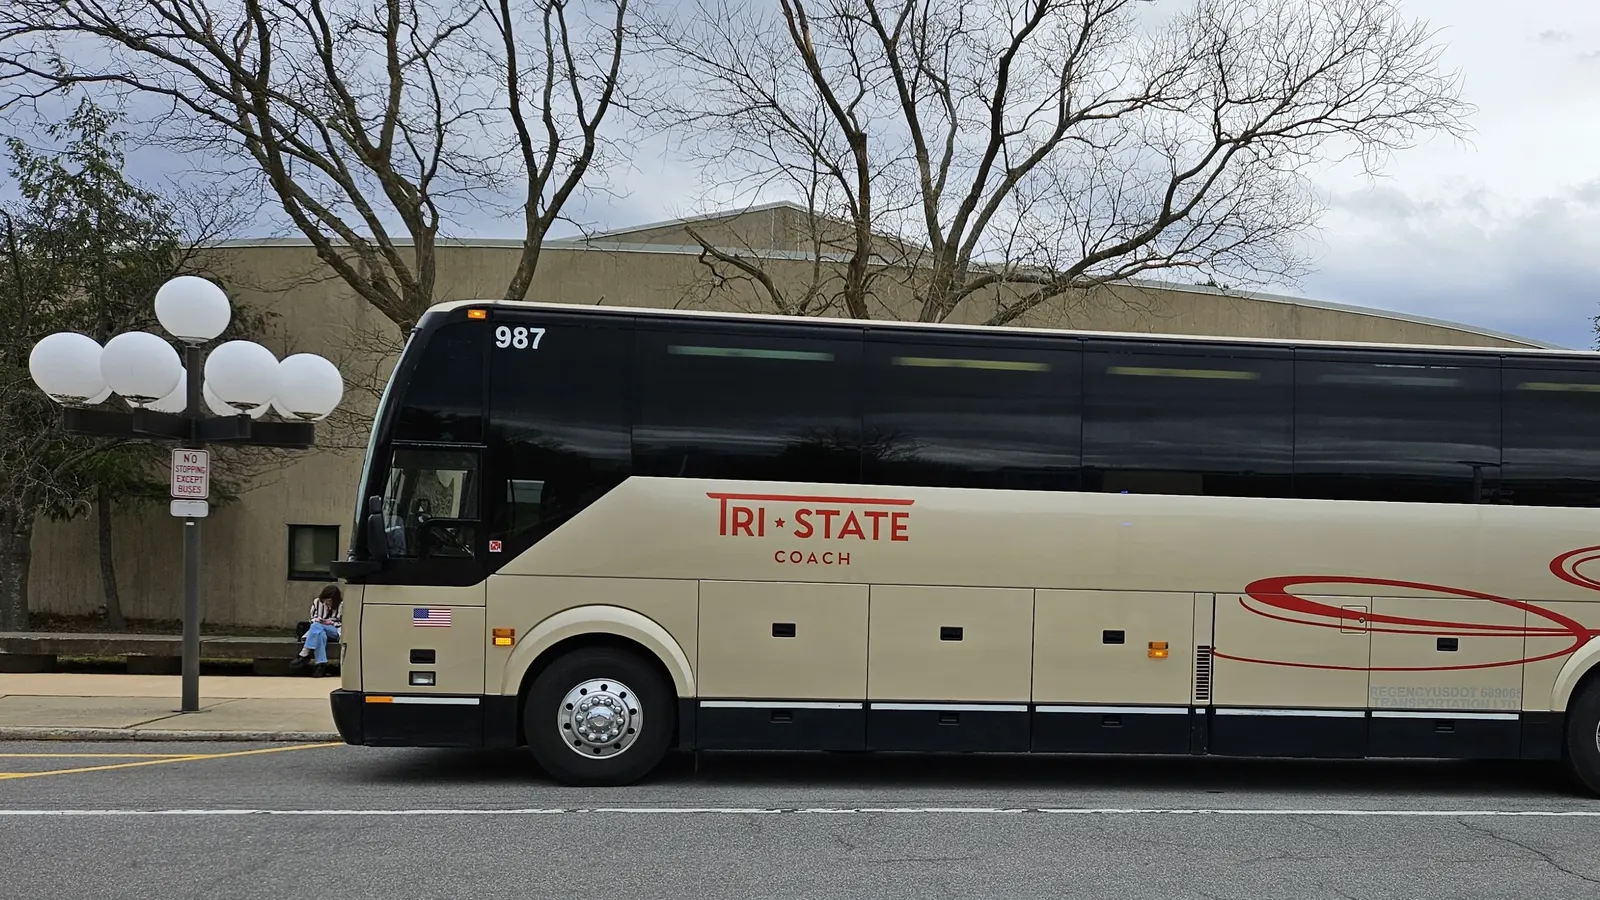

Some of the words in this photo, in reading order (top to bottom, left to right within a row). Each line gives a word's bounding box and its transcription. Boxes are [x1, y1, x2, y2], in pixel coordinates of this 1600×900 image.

[495, 325, 546, 350] 987
[183, 454, 198, 464] NO
[175, 464, 206, 474] STOPPING
[176, 474, 204, 484] EXCEPT
[177, 484, 202, 494] BUSES
[706, 492, 766, 537] TRI
[793, 508, 910, 542] STATE
[774, 550, 851, 566] COACH
[1371, 697, 1490, 709] TRANSPORTATION
